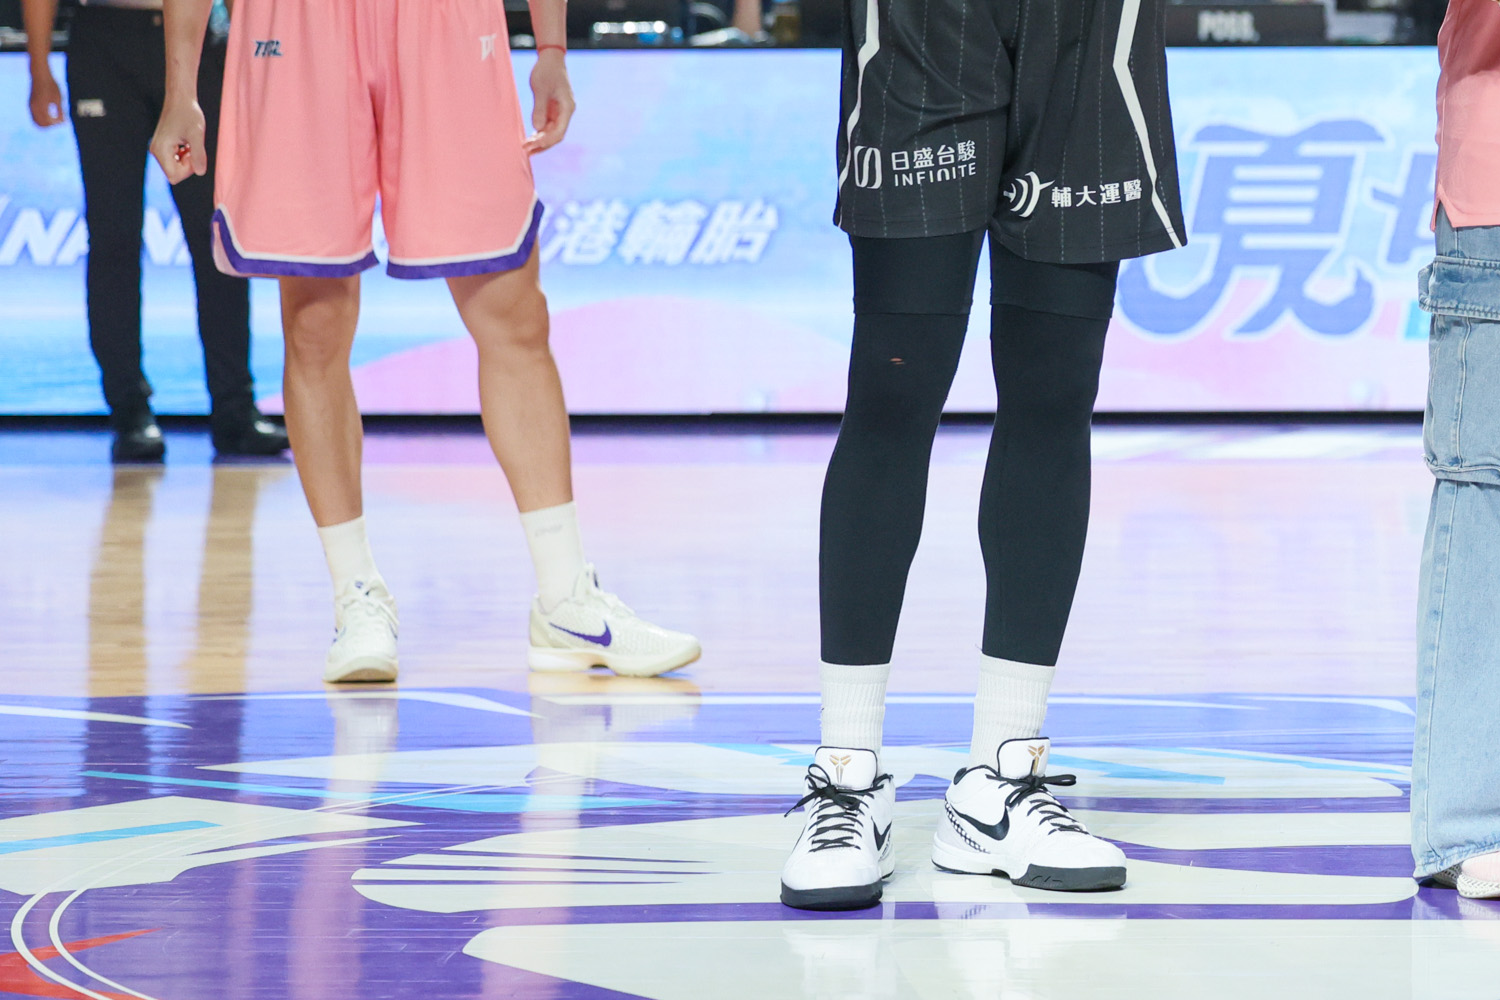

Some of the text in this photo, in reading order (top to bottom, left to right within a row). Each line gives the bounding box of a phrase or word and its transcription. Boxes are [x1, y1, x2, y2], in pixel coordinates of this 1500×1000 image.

[891, 140, 976, 171] 日盛台駿
[1051, 178, 1142, 208] 輔大運醫
[538, 199, 779, 265] 港輪胎
